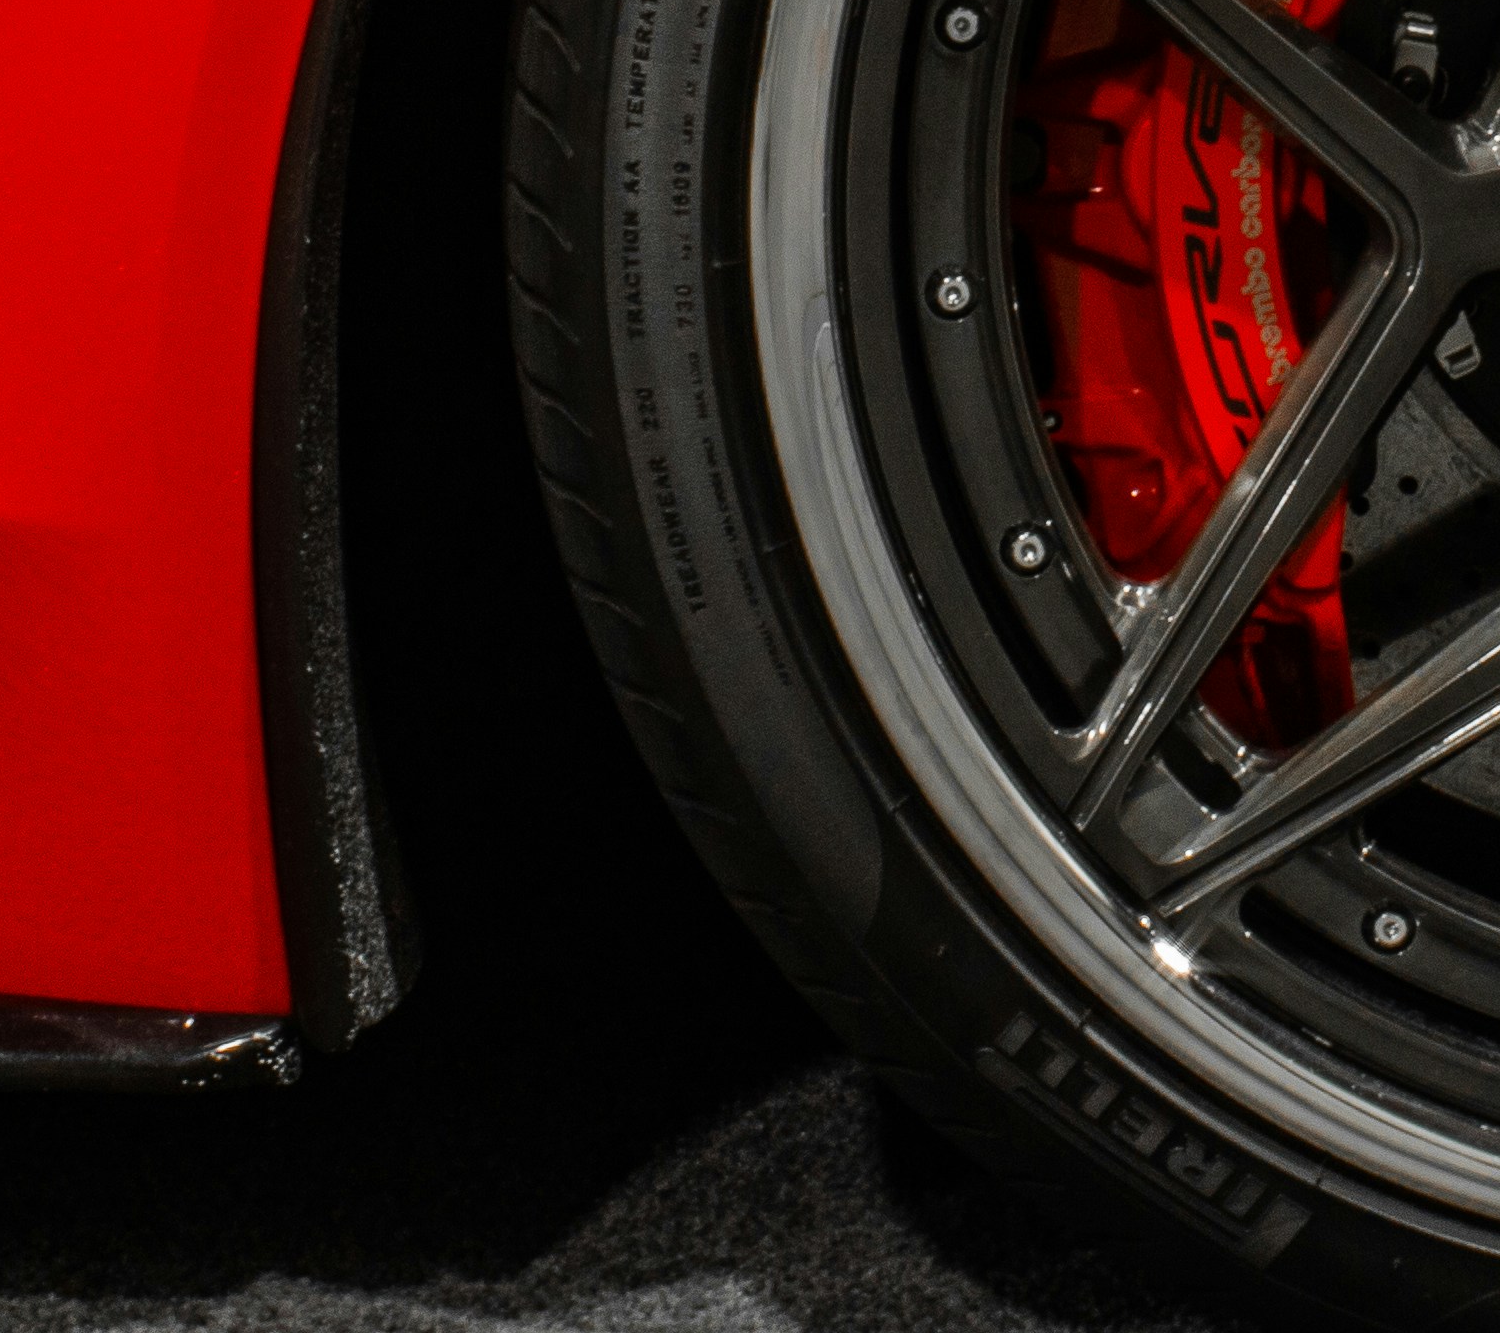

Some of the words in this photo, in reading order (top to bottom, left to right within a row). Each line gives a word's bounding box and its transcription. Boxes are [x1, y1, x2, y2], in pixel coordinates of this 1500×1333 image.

[619, 208, 648, 340] TRACTION
[1240, 247, 1296, 387] brembo
[645, 454, 708, 613] TREADWEAR
[974, 1010, 1313, 1270] PIRELLI
